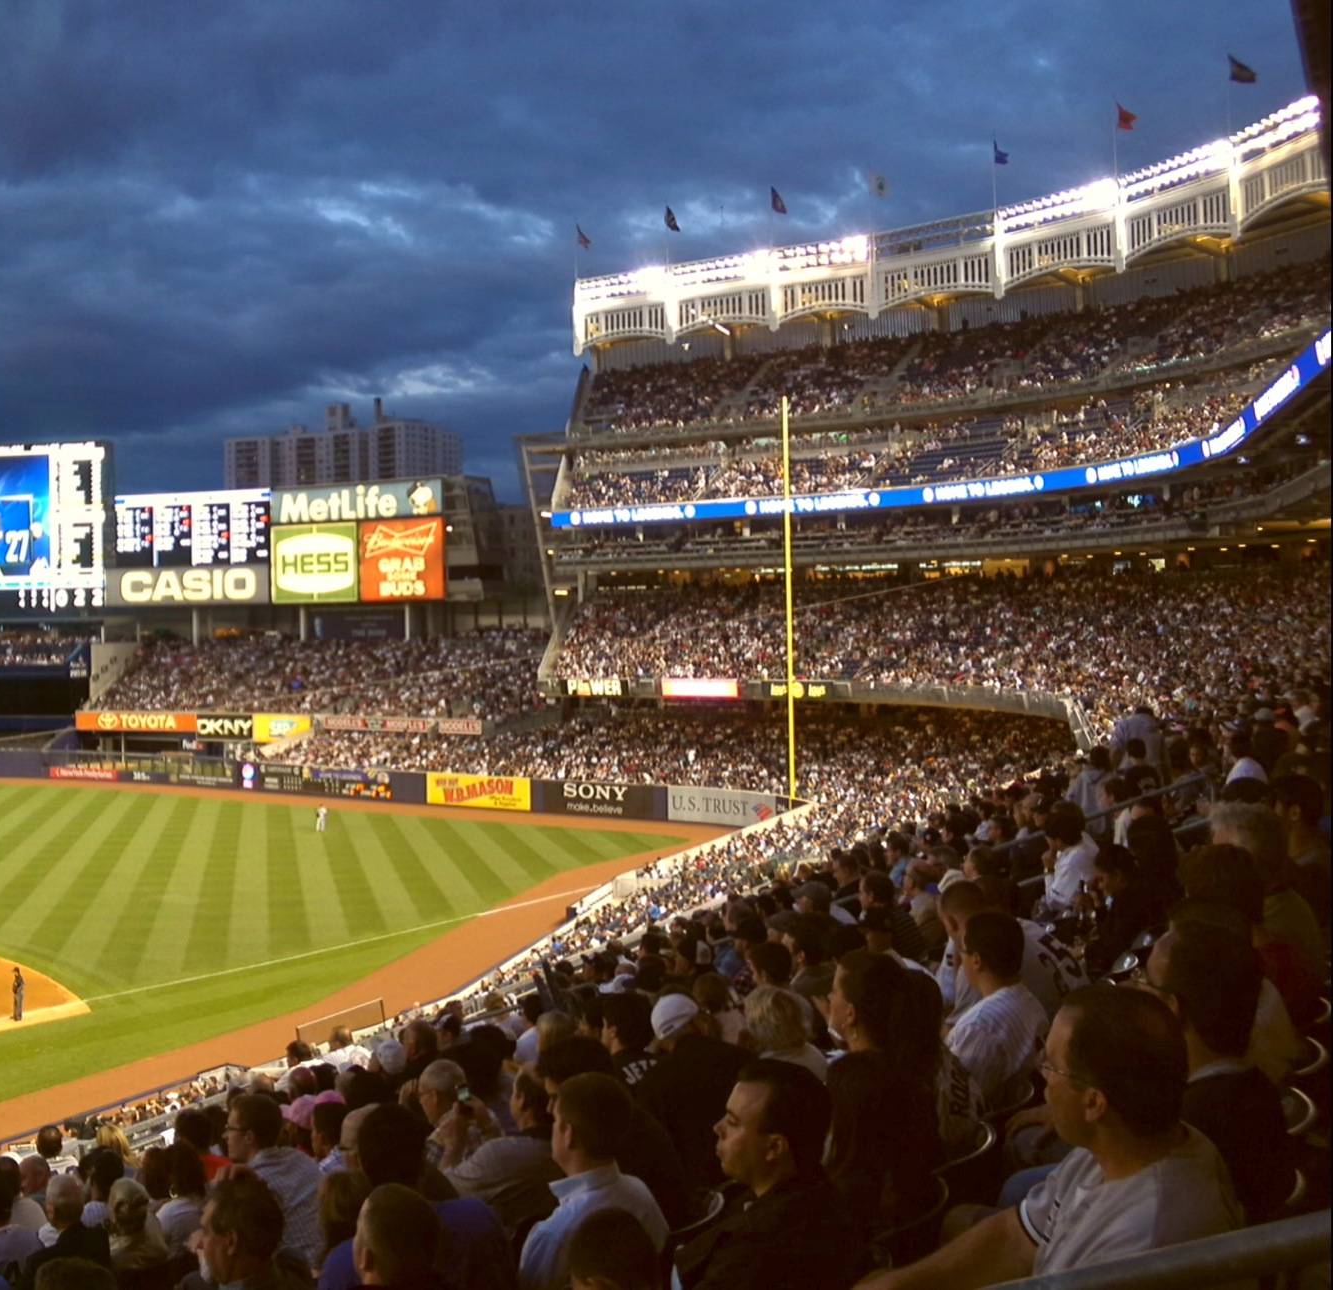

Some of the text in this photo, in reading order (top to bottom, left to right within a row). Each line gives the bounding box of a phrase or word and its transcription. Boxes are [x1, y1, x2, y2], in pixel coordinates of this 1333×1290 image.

[279, 485, 397, 523] MetLife
[6, 529, 30, 563] 27
[282, 553, 349, 576] HESS
[378, 557, 425, 573] GRAB
[120, 568, 257, 602] CASIO
[380, 580, 425, 597] BUDS
[120, 714, 176, 728] TOYOTA
[197, 719, 252, 735] DKNY
[563, 784, 628, 801] SONY
[566, 803, 623, 815] make.believe
[671, 796, 749, 816] U.S. TRUST
